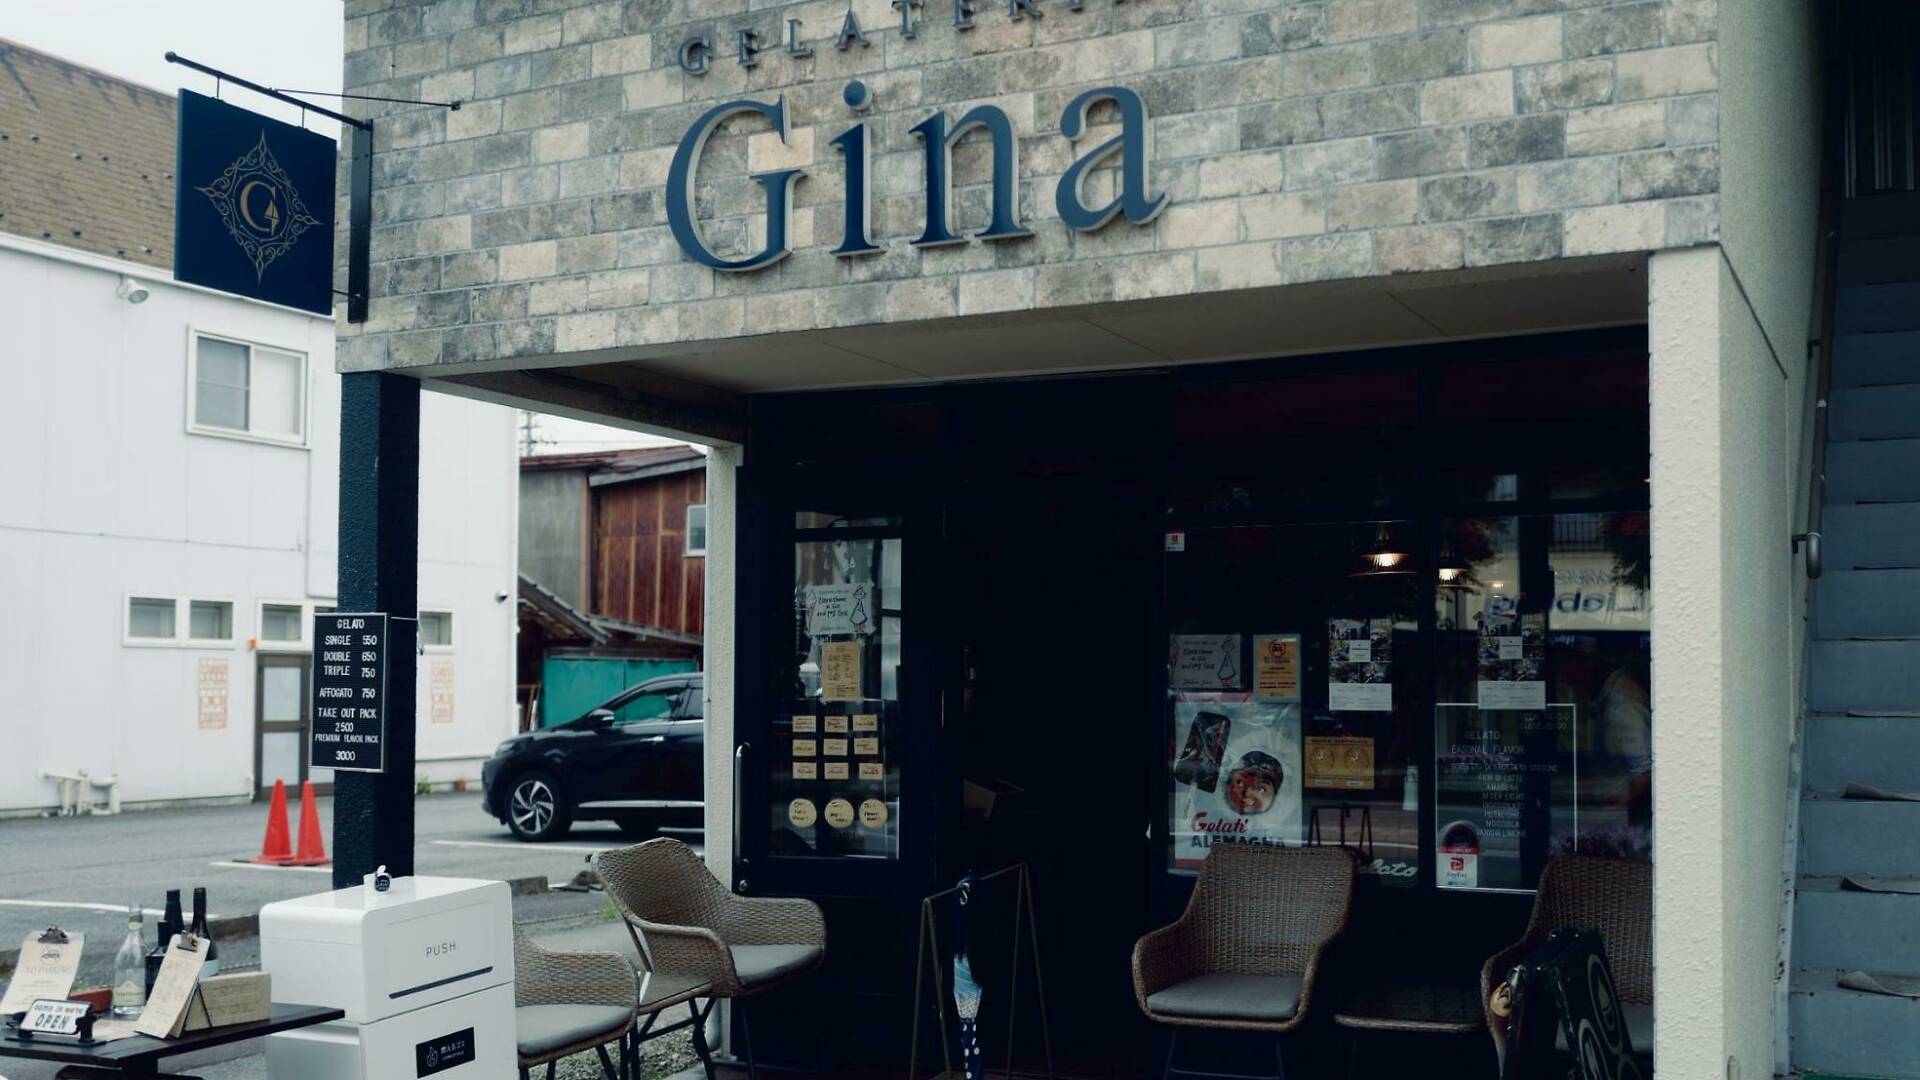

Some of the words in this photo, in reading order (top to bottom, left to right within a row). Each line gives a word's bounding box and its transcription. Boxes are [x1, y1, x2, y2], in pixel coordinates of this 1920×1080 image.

[665, 80, 1171, 272] Gina
[336, 618, 365, 629] GELATO
[325, 635, 351, 646] SINGLE
[362, 635, 377, 646] 550
[324, 651, 351, 661] DOUBLE
[361, 651, 376, 661] 650
[323, 665, 350, 676] TRIPLE
[361, 667, 376, 678] 750
[319, 687, 353, 698] AFFOGATO
[361, 687, 376, 699] 750
[318, 707, 338, 718] TAKE
[340, 707, 356, 718] OUT
[359, 708, 377, 719] PACK
[335, 722, 354, 732] 2500
[315, 733, 341, 742] PREMIUM
[343, 734, 364, 743] FLAVOR
[364, 735, 379, 744] PACK
[335, 750, 356, 761] 3000
[426, 941, 456, 958] PUSH
[34, 1013, 70, 1029] OPEN
